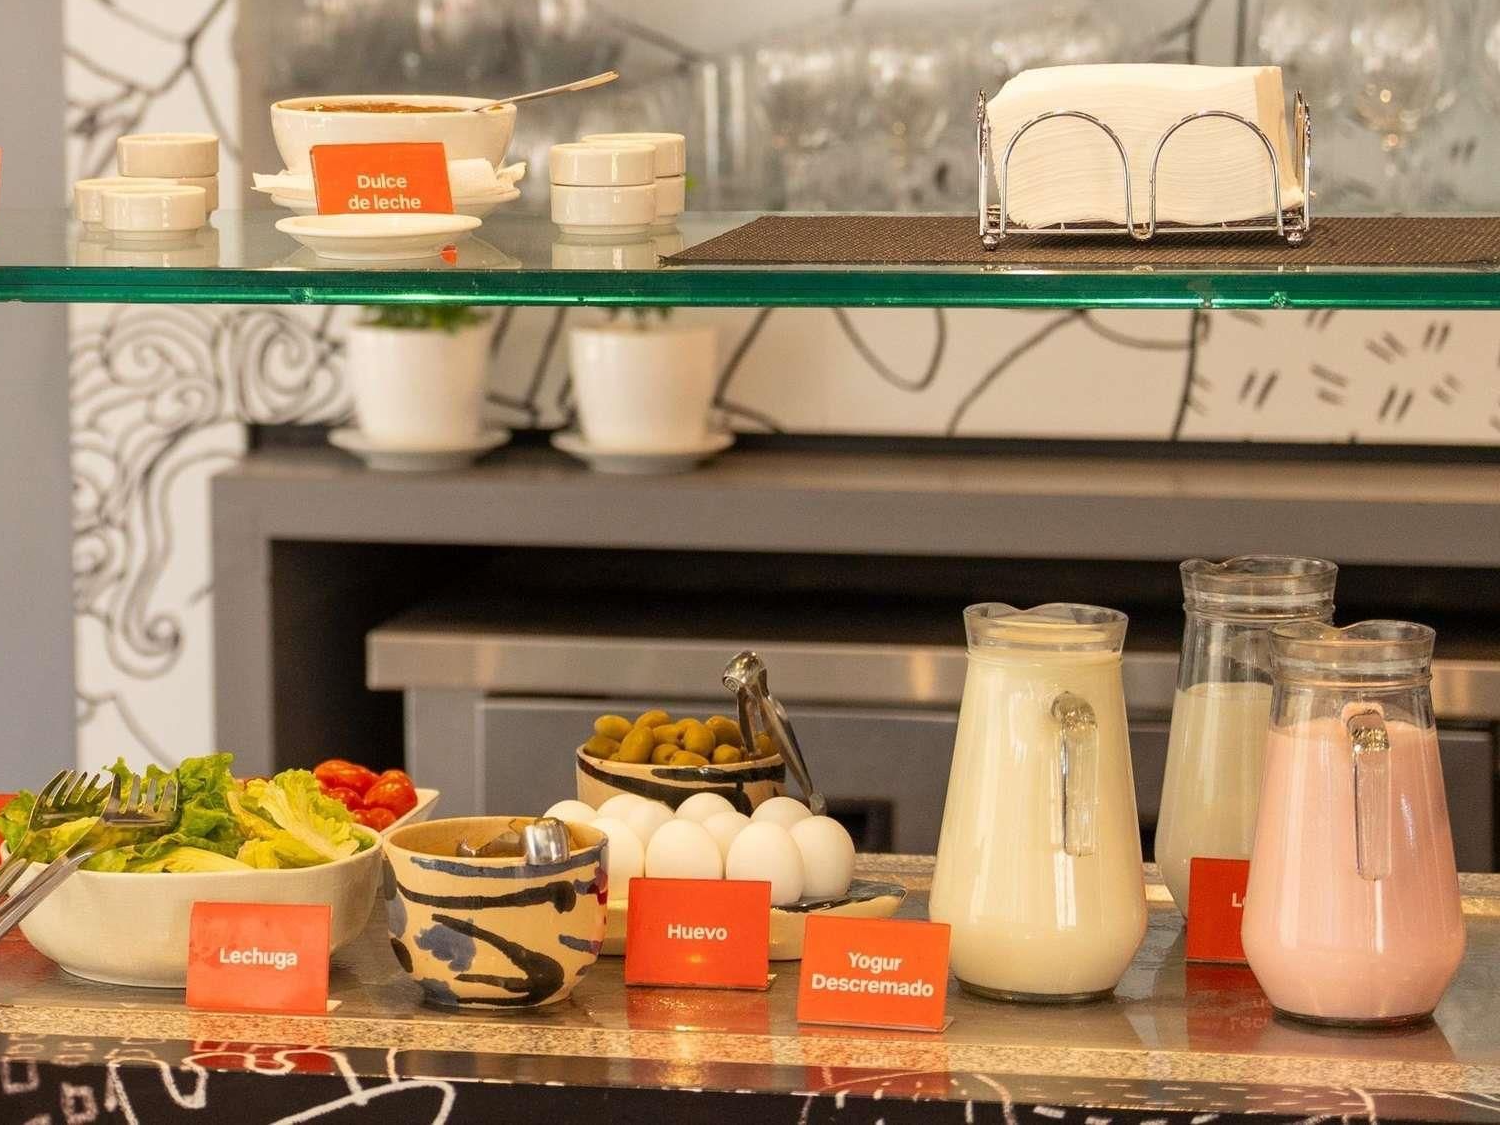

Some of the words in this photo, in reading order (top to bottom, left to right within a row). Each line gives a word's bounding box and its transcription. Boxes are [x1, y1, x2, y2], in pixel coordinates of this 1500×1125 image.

[357, 173, 408, 189] Dulce
[347, 194, 370, 210] de
[373, 194, 422, 211] leche
[667, 923, 728, 941] Huevo
[219, 947, 298, 971] Lechuga
[848, 951, 903, 973] Yogur
[811, 974, 934, 997] Descremado
